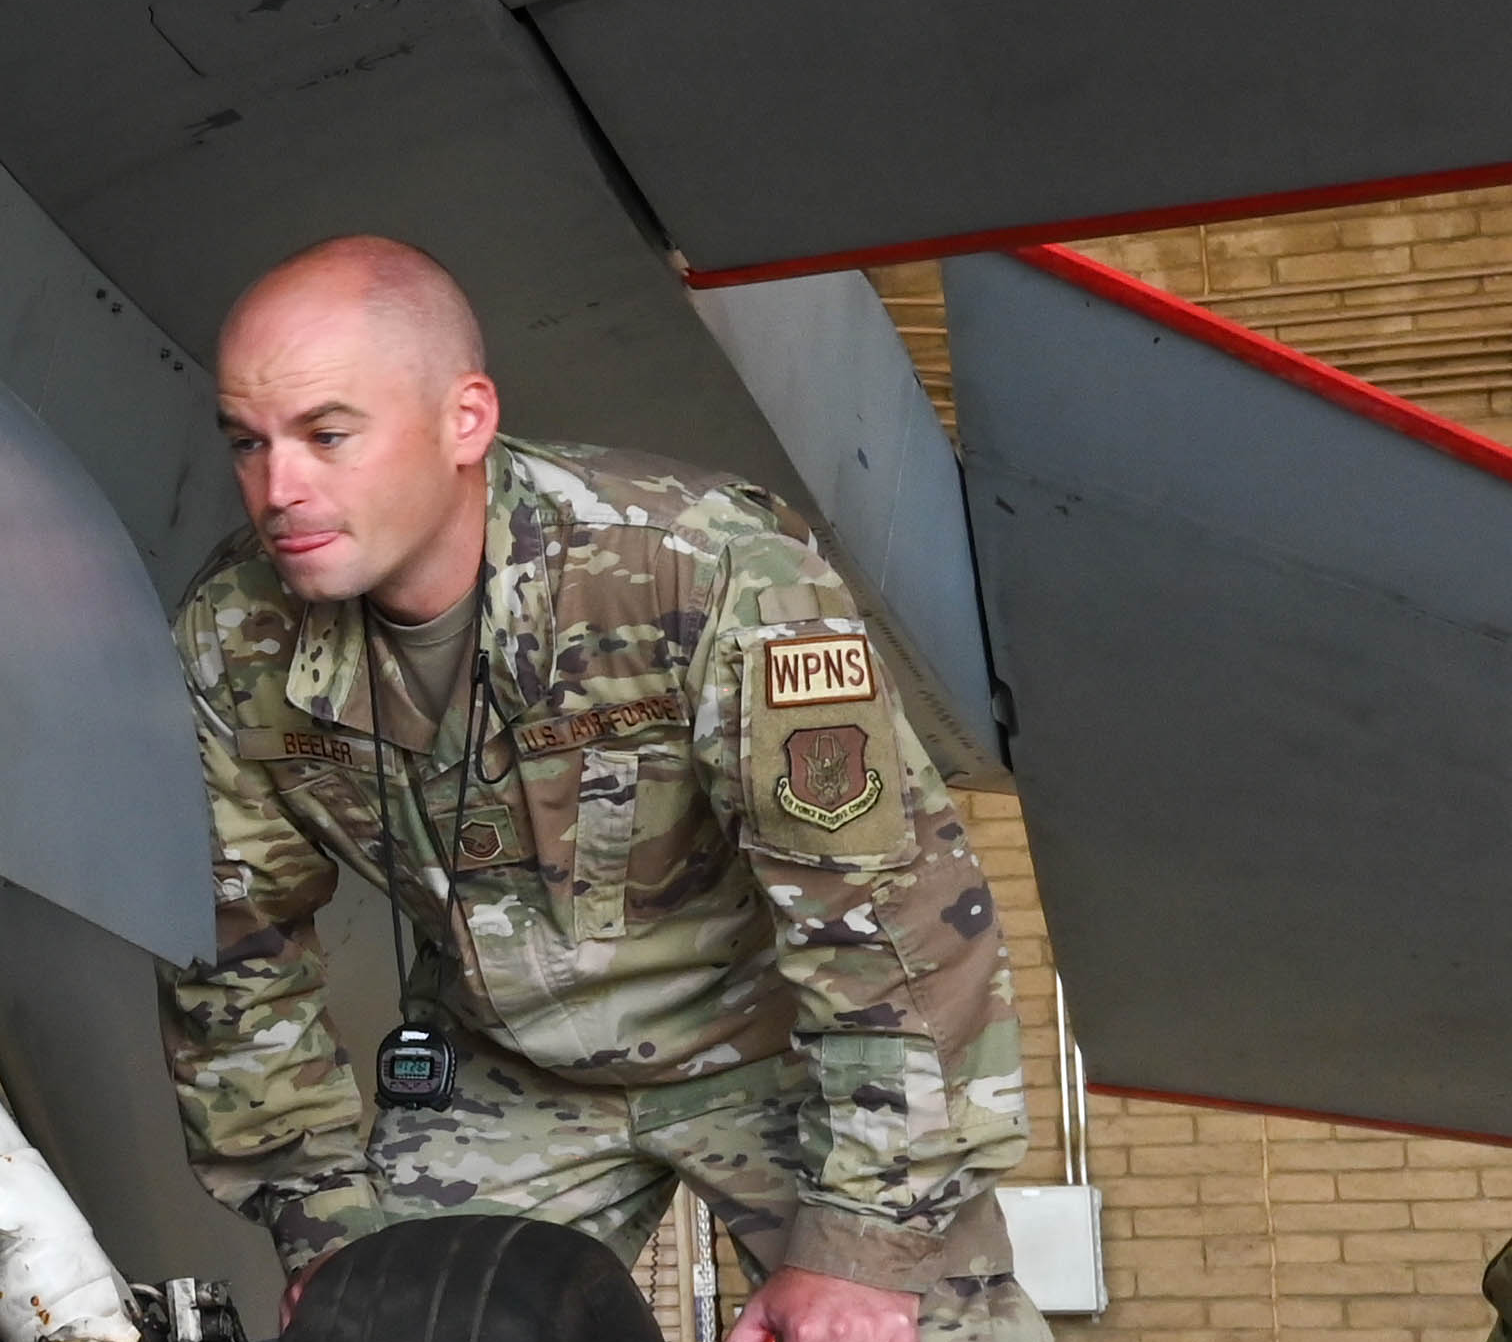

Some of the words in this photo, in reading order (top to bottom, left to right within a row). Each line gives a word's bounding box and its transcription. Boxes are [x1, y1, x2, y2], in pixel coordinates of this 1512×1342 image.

[772, 652, 868, 697] WPNS
[568, 710, 606, 742] AIR
[607, 697, 678, 732] FORCE
[283, 730, 353, 765] BEELER
